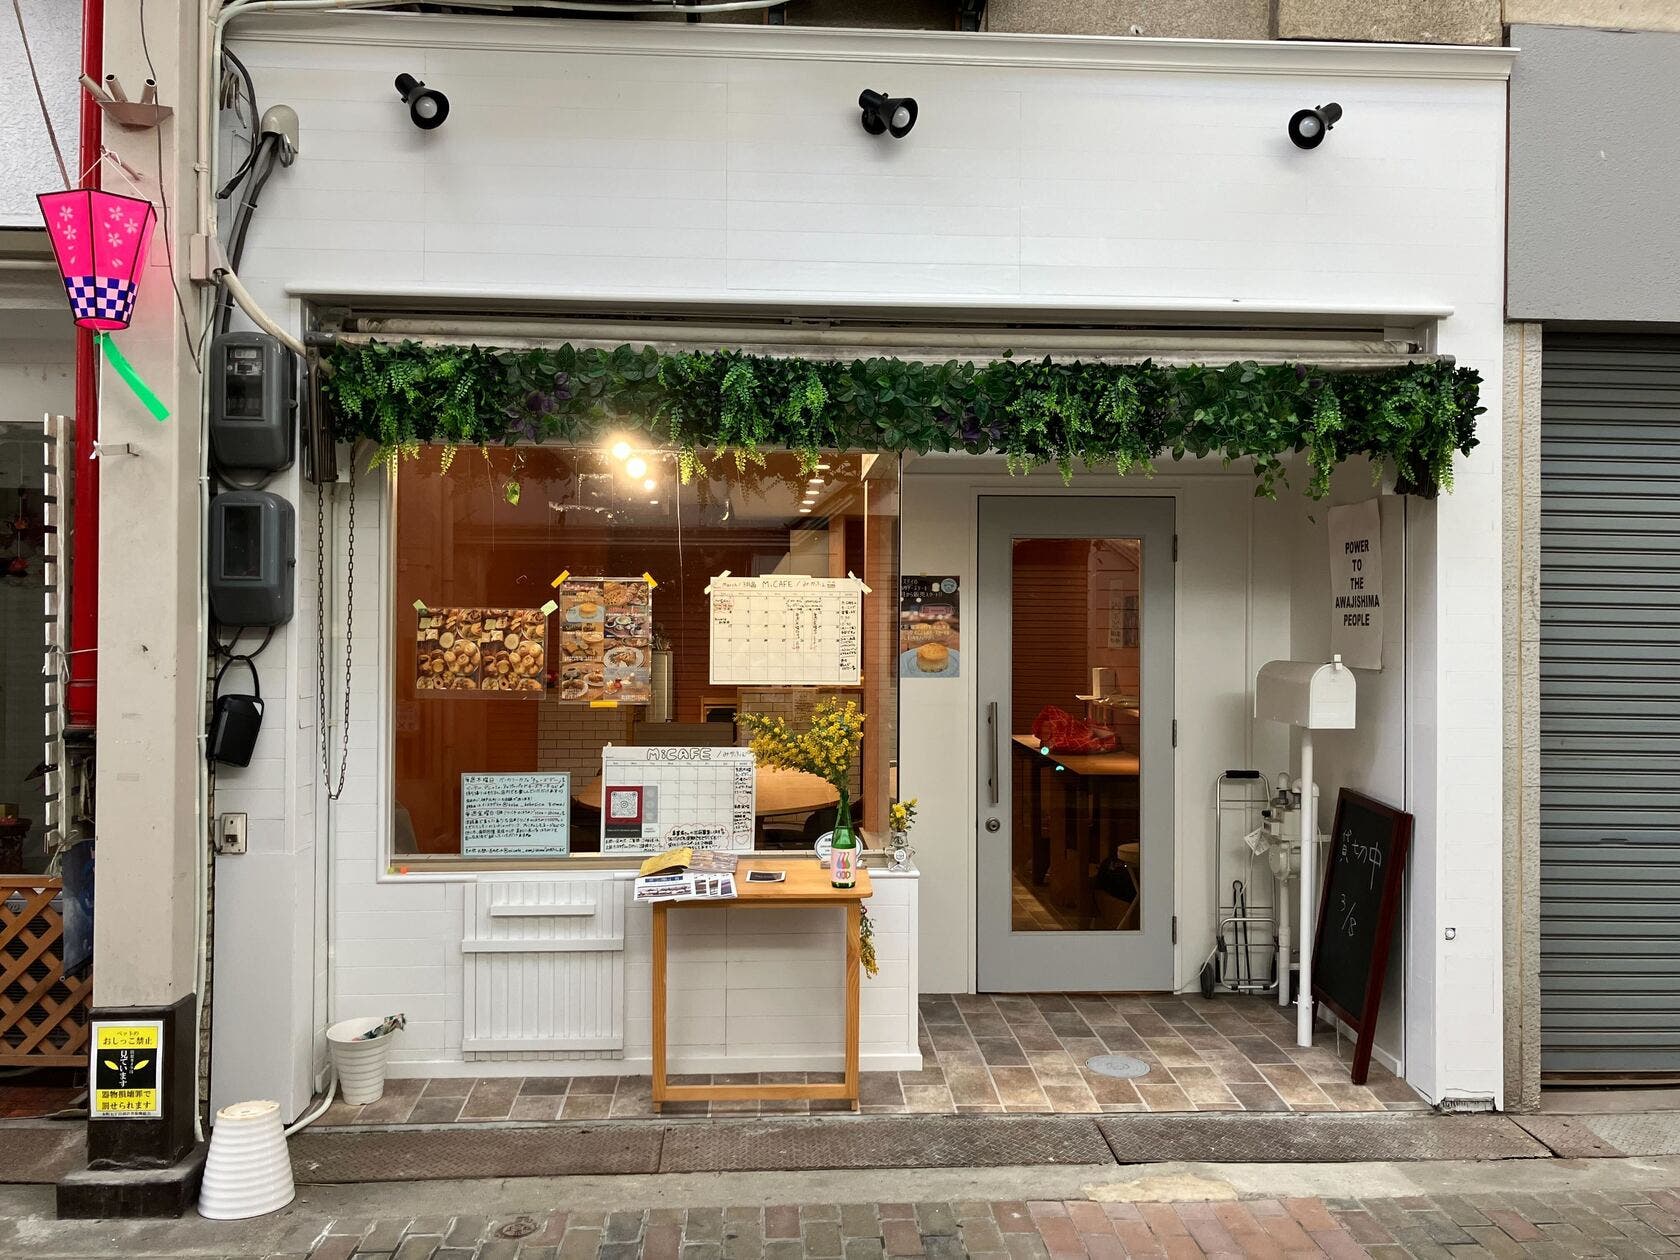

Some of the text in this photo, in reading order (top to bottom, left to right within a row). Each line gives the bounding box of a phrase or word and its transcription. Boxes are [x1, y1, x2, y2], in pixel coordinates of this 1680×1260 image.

[1345, 540, 1369, 554] POWER
[1352, 559, 1362, 572] TO
[1350, 577, 1364, 590] THE
[1335, 594, 1380, 609] AWAJISHIMA
[1343, 613, 1370, 626] PEOPLE
[102, 1037, 153, 1045] おしっこ禁止
[119, 1049, 128, 1088] 見ています
[101, 1090, 152, 1099] 器物損壊罪で
[101, 1101, 152, 1110] 罰せられます
